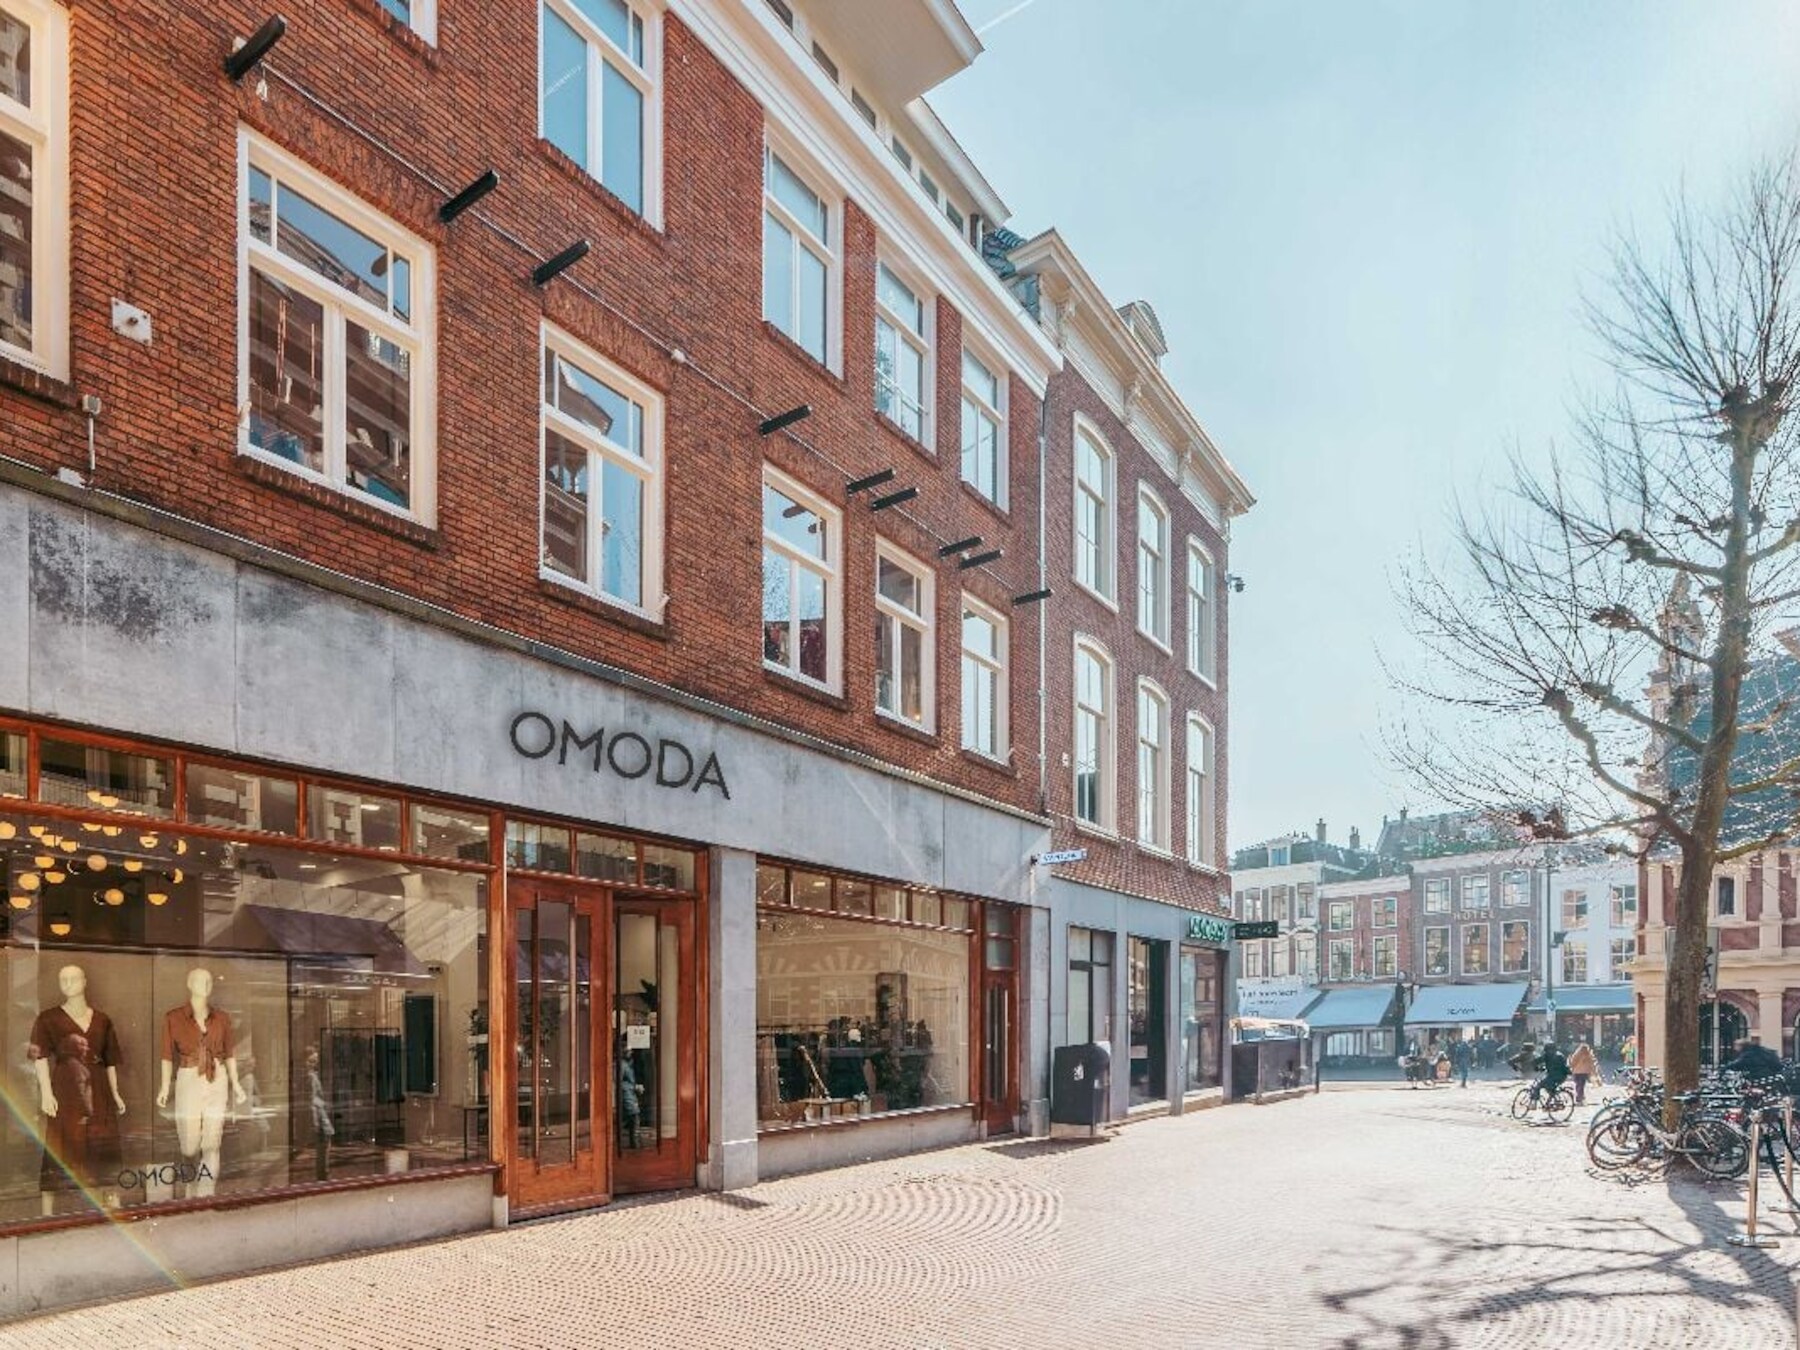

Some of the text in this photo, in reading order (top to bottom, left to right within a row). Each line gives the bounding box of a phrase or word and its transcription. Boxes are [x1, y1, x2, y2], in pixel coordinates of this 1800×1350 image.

[510, 712, 731, 800] OMODA
[1452, 910, 1496, 920] HOTEL
[118, 1163, 213, 1189] OMODA
